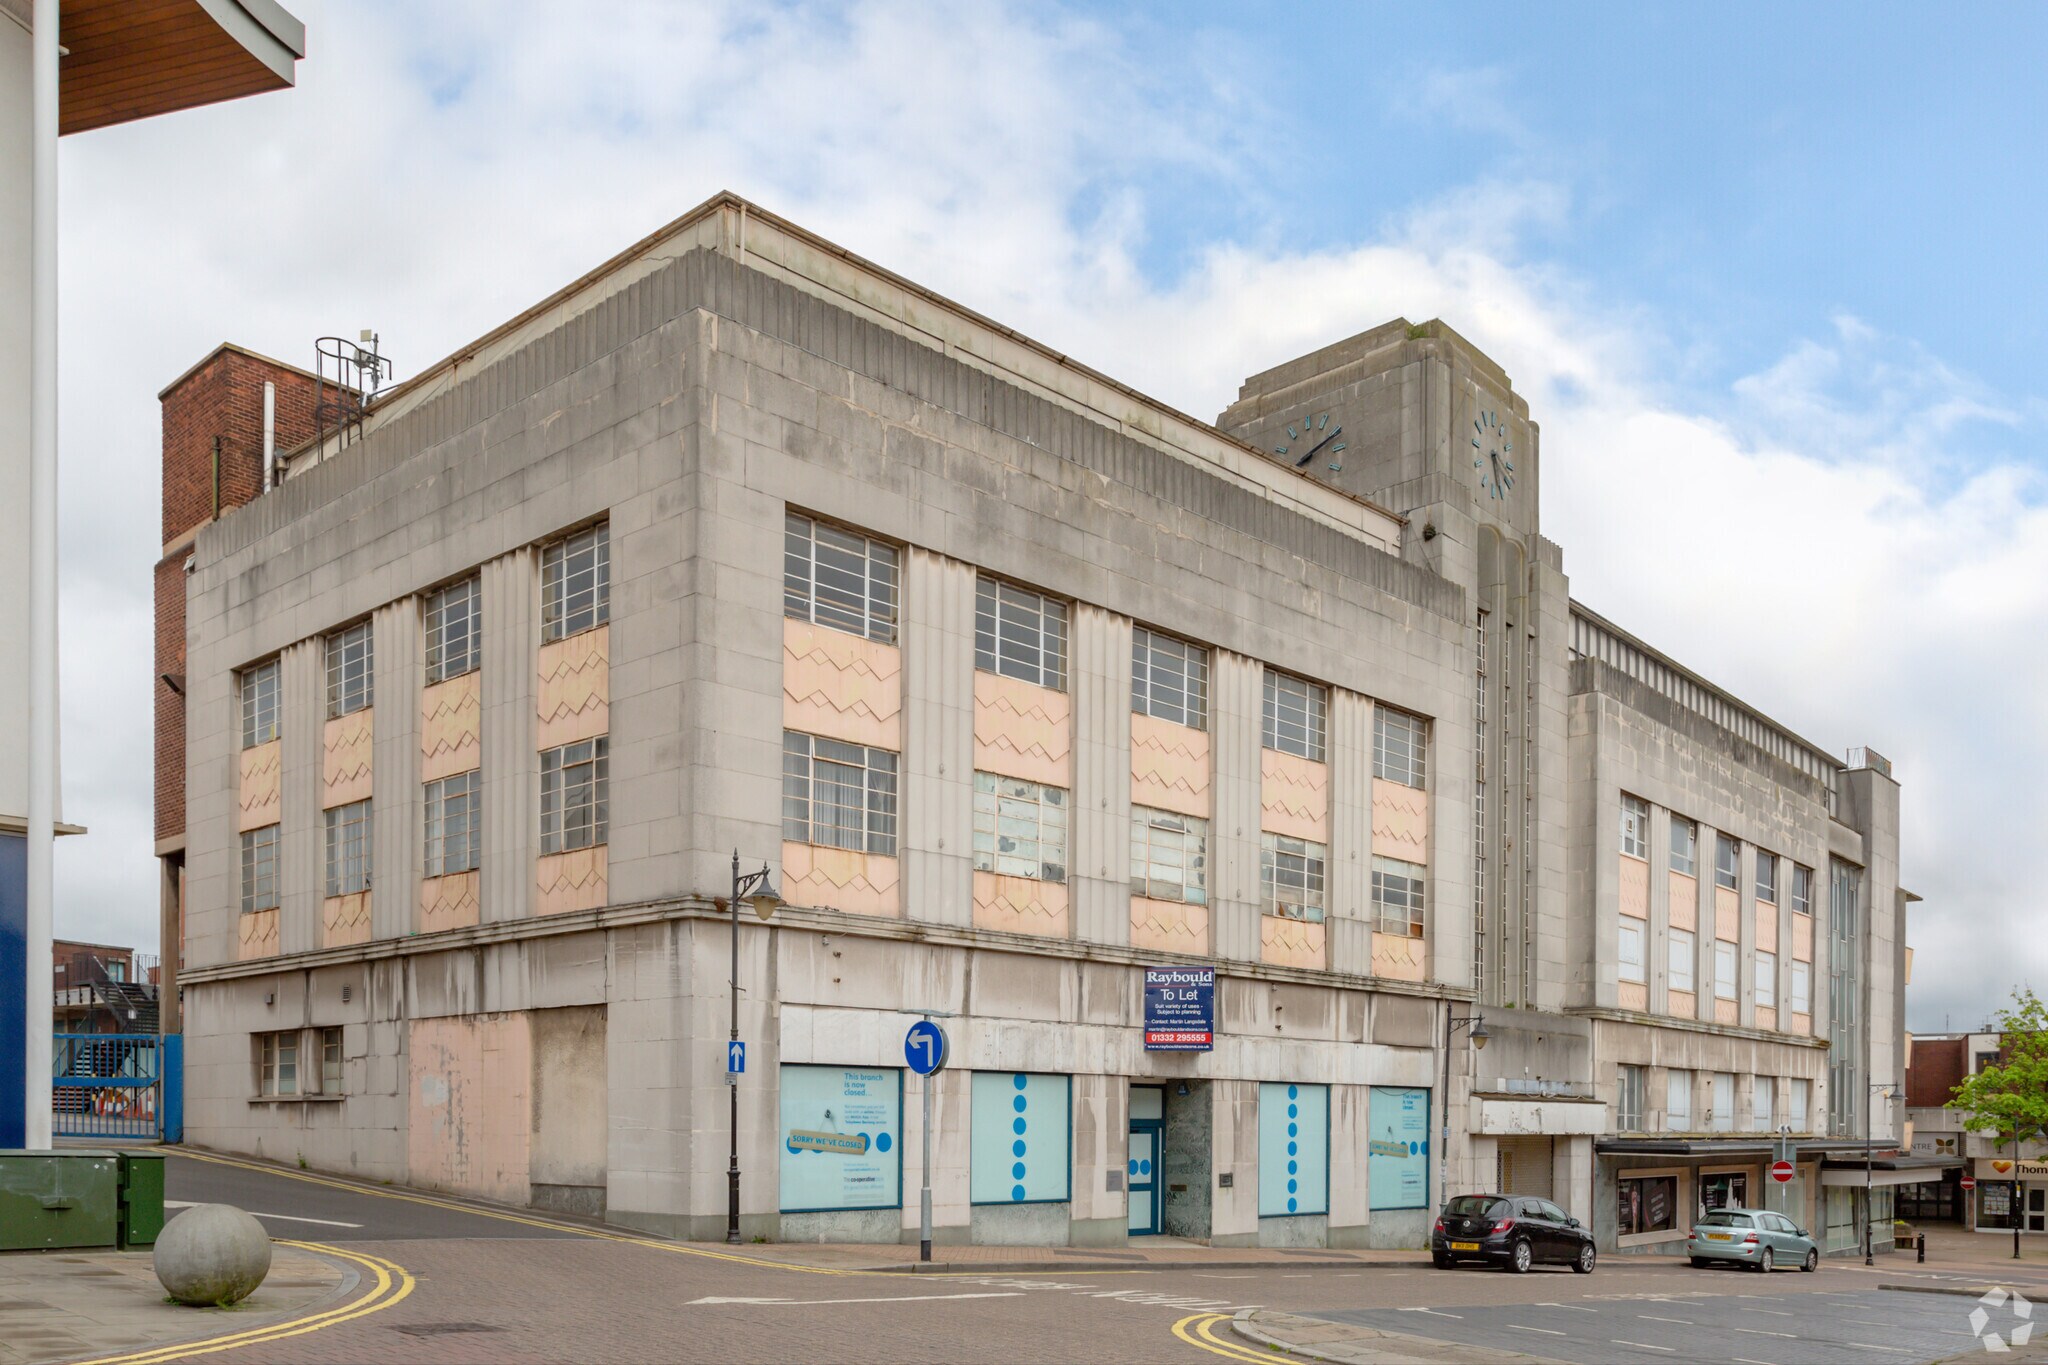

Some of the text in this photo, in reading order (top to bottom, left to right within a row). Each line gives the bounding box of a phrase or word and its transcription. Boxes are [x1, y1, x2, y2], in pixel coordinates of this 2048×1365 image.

[1147, 972, 1212, 986] Raybould
[1160, 989, 1198, 1000] To Let
[860, 1073, 883, 1081] branch
[793, 1135, 814, 1144] SORRY
